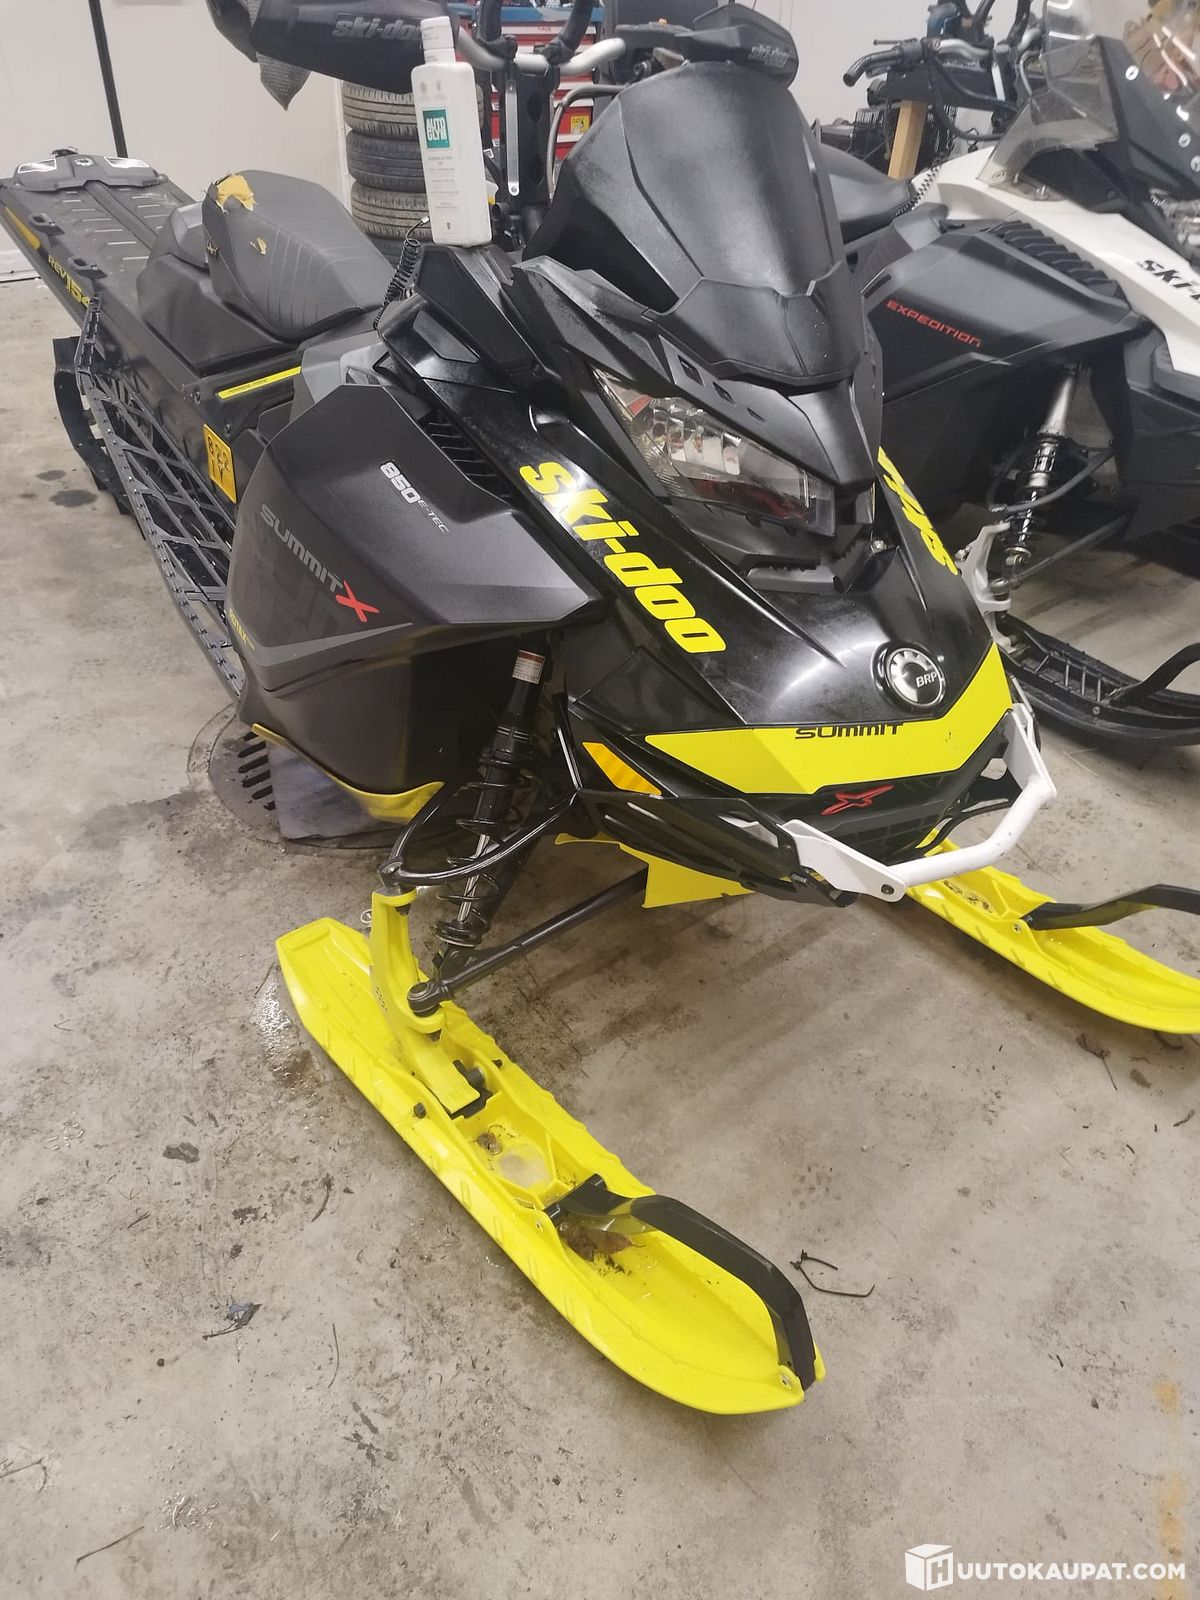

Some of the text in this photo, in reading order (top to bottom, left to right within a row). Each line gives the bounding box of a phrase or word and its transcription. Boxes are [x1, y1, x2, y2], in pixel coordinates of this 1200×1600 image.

[332, 16, 419, 40] ski-do
[426, 117, 446, 130] AUTO
[887, 300, 981, 348] EXPEDITION
[380, 461, 421, 504] 850
[260, 504, 344, 593] SUMMIT
[915, 672, 938, 689] BRP
[795, 723, 904, 739] SUMMIT
